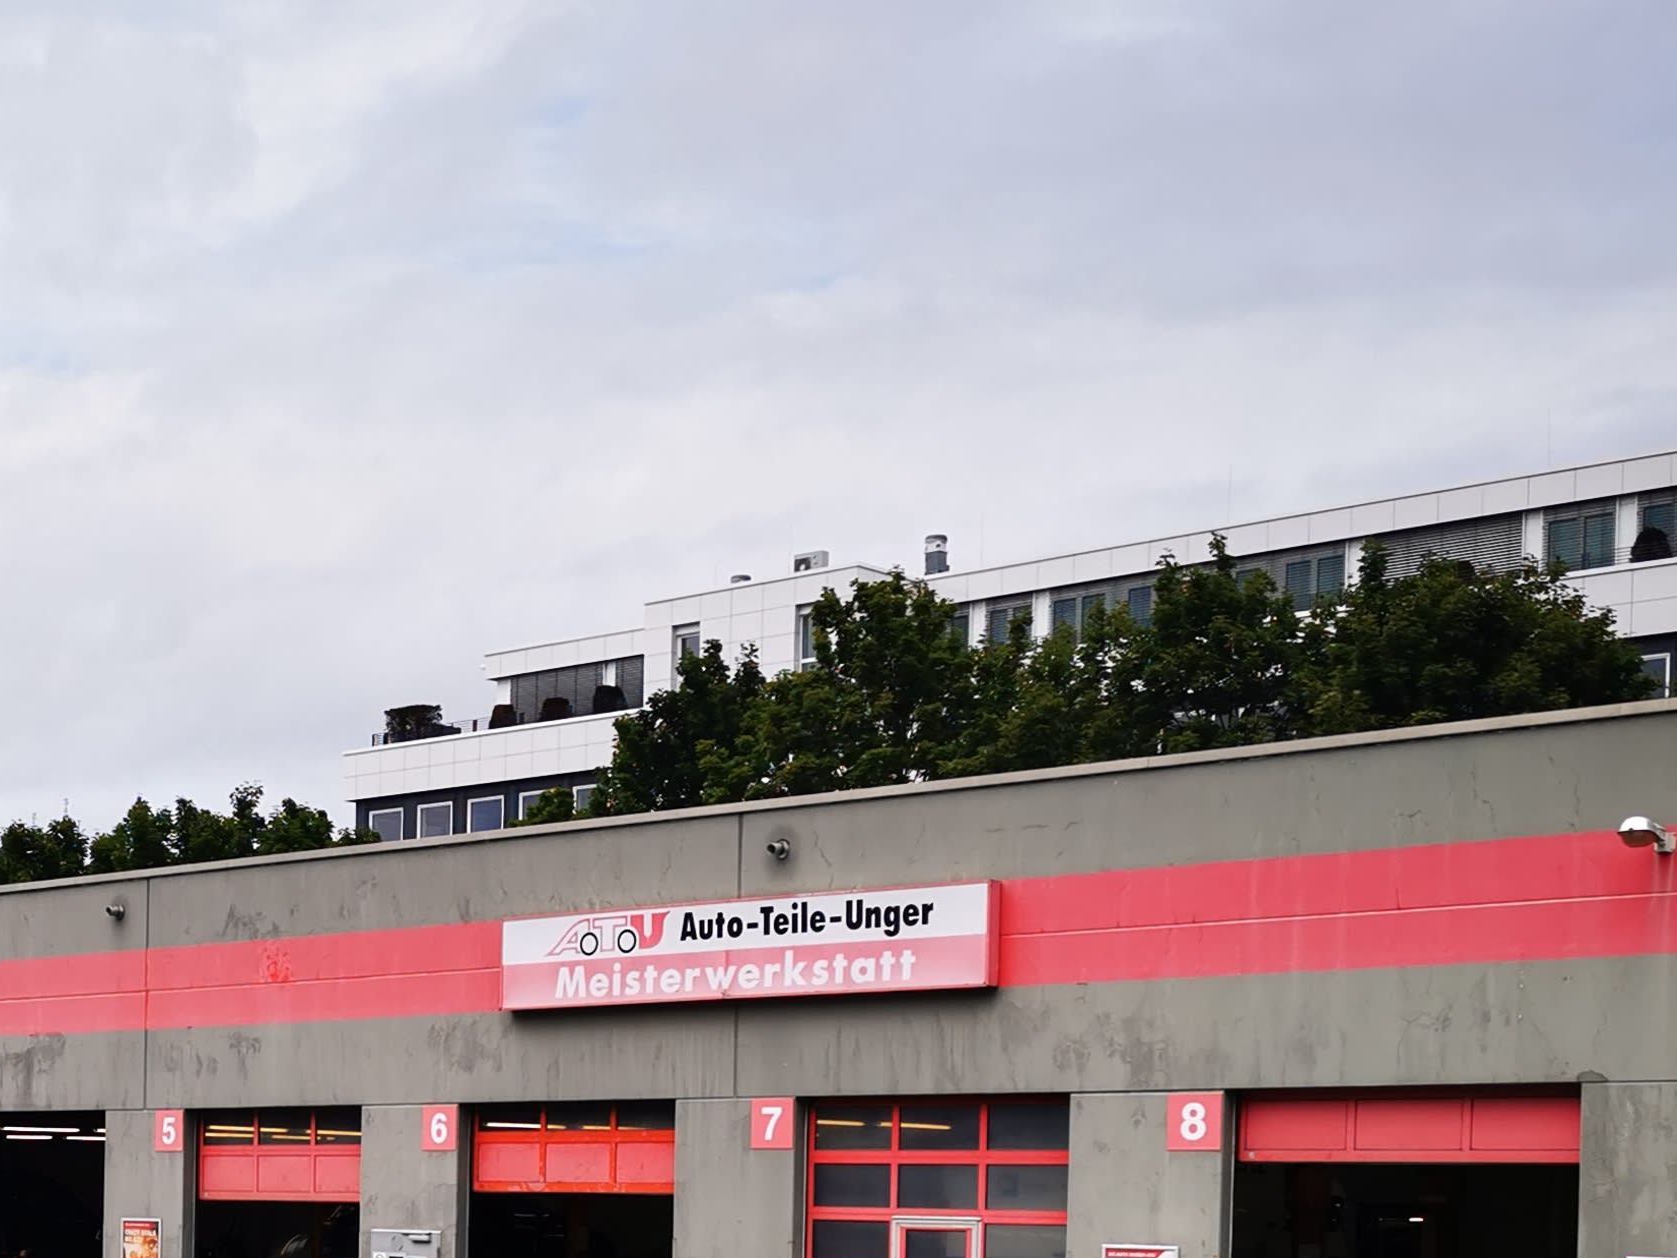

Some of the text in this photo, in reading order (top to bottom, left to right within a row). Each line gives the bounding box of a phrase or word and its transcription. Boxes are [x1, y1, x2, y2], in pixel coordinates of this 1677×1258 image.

[680, 899, 934, 942] Auto-Teile-Unger
[555, 948, 916, 999] Meisterwerkstatt
[162, 1116, 176, 1145] 5
[430, 1112, 448, 1144] 6
[761, 1106, 782, 1141] 7
[1180, 1102, 1207, 1141] 8
